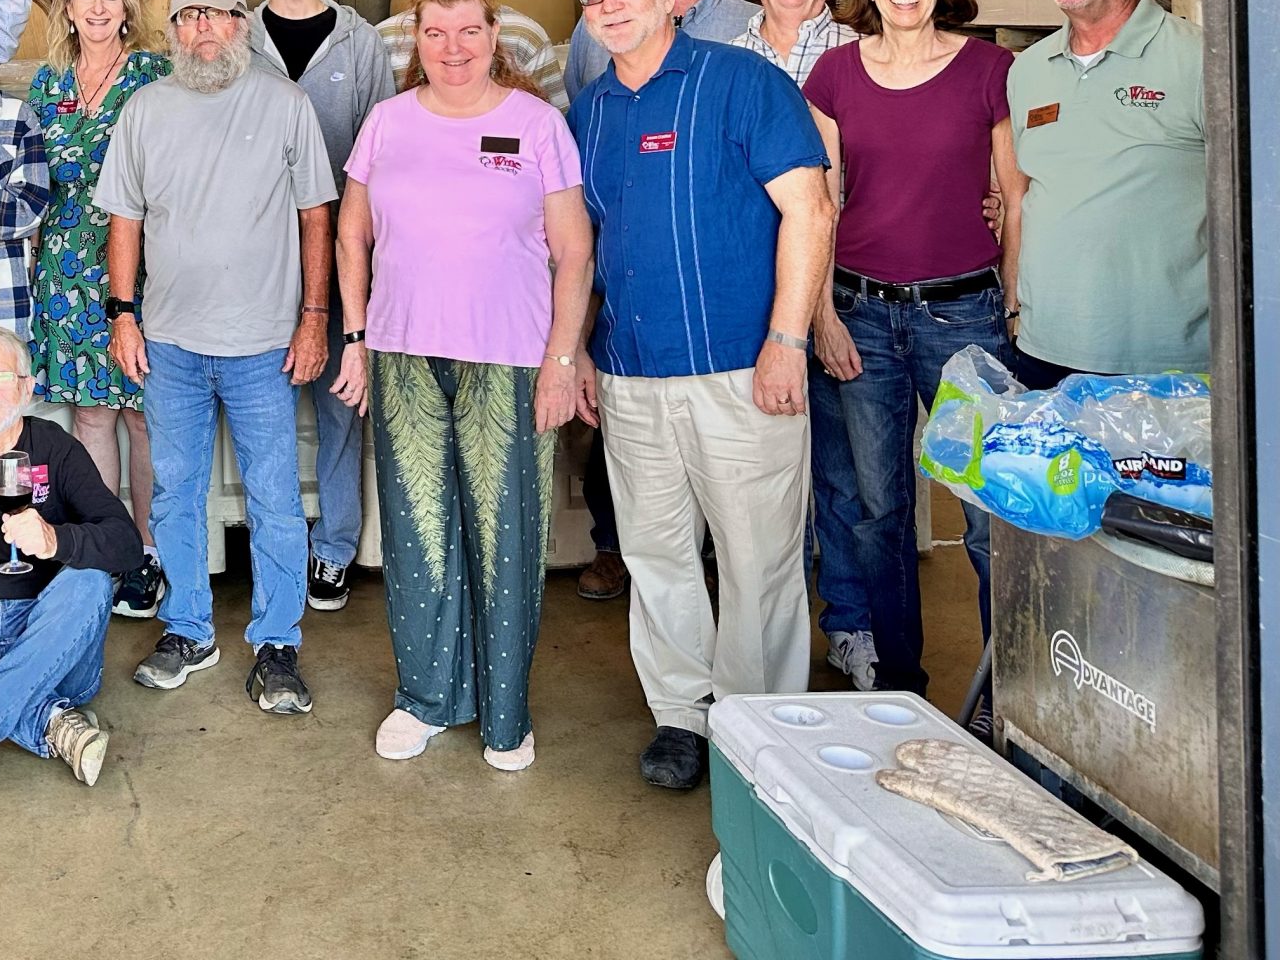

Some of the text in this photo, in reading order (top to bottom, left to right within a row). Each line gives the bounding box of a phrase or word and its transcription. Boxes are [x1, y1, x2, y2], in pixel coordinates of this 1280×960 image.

[1129, 86, 1166, 101] Wine
[1131, 101, 1160, 111] Society
[1115, 453, 1184, 472] KIRAND
[1051, 630, 1156, 728] ADVANTAGE
